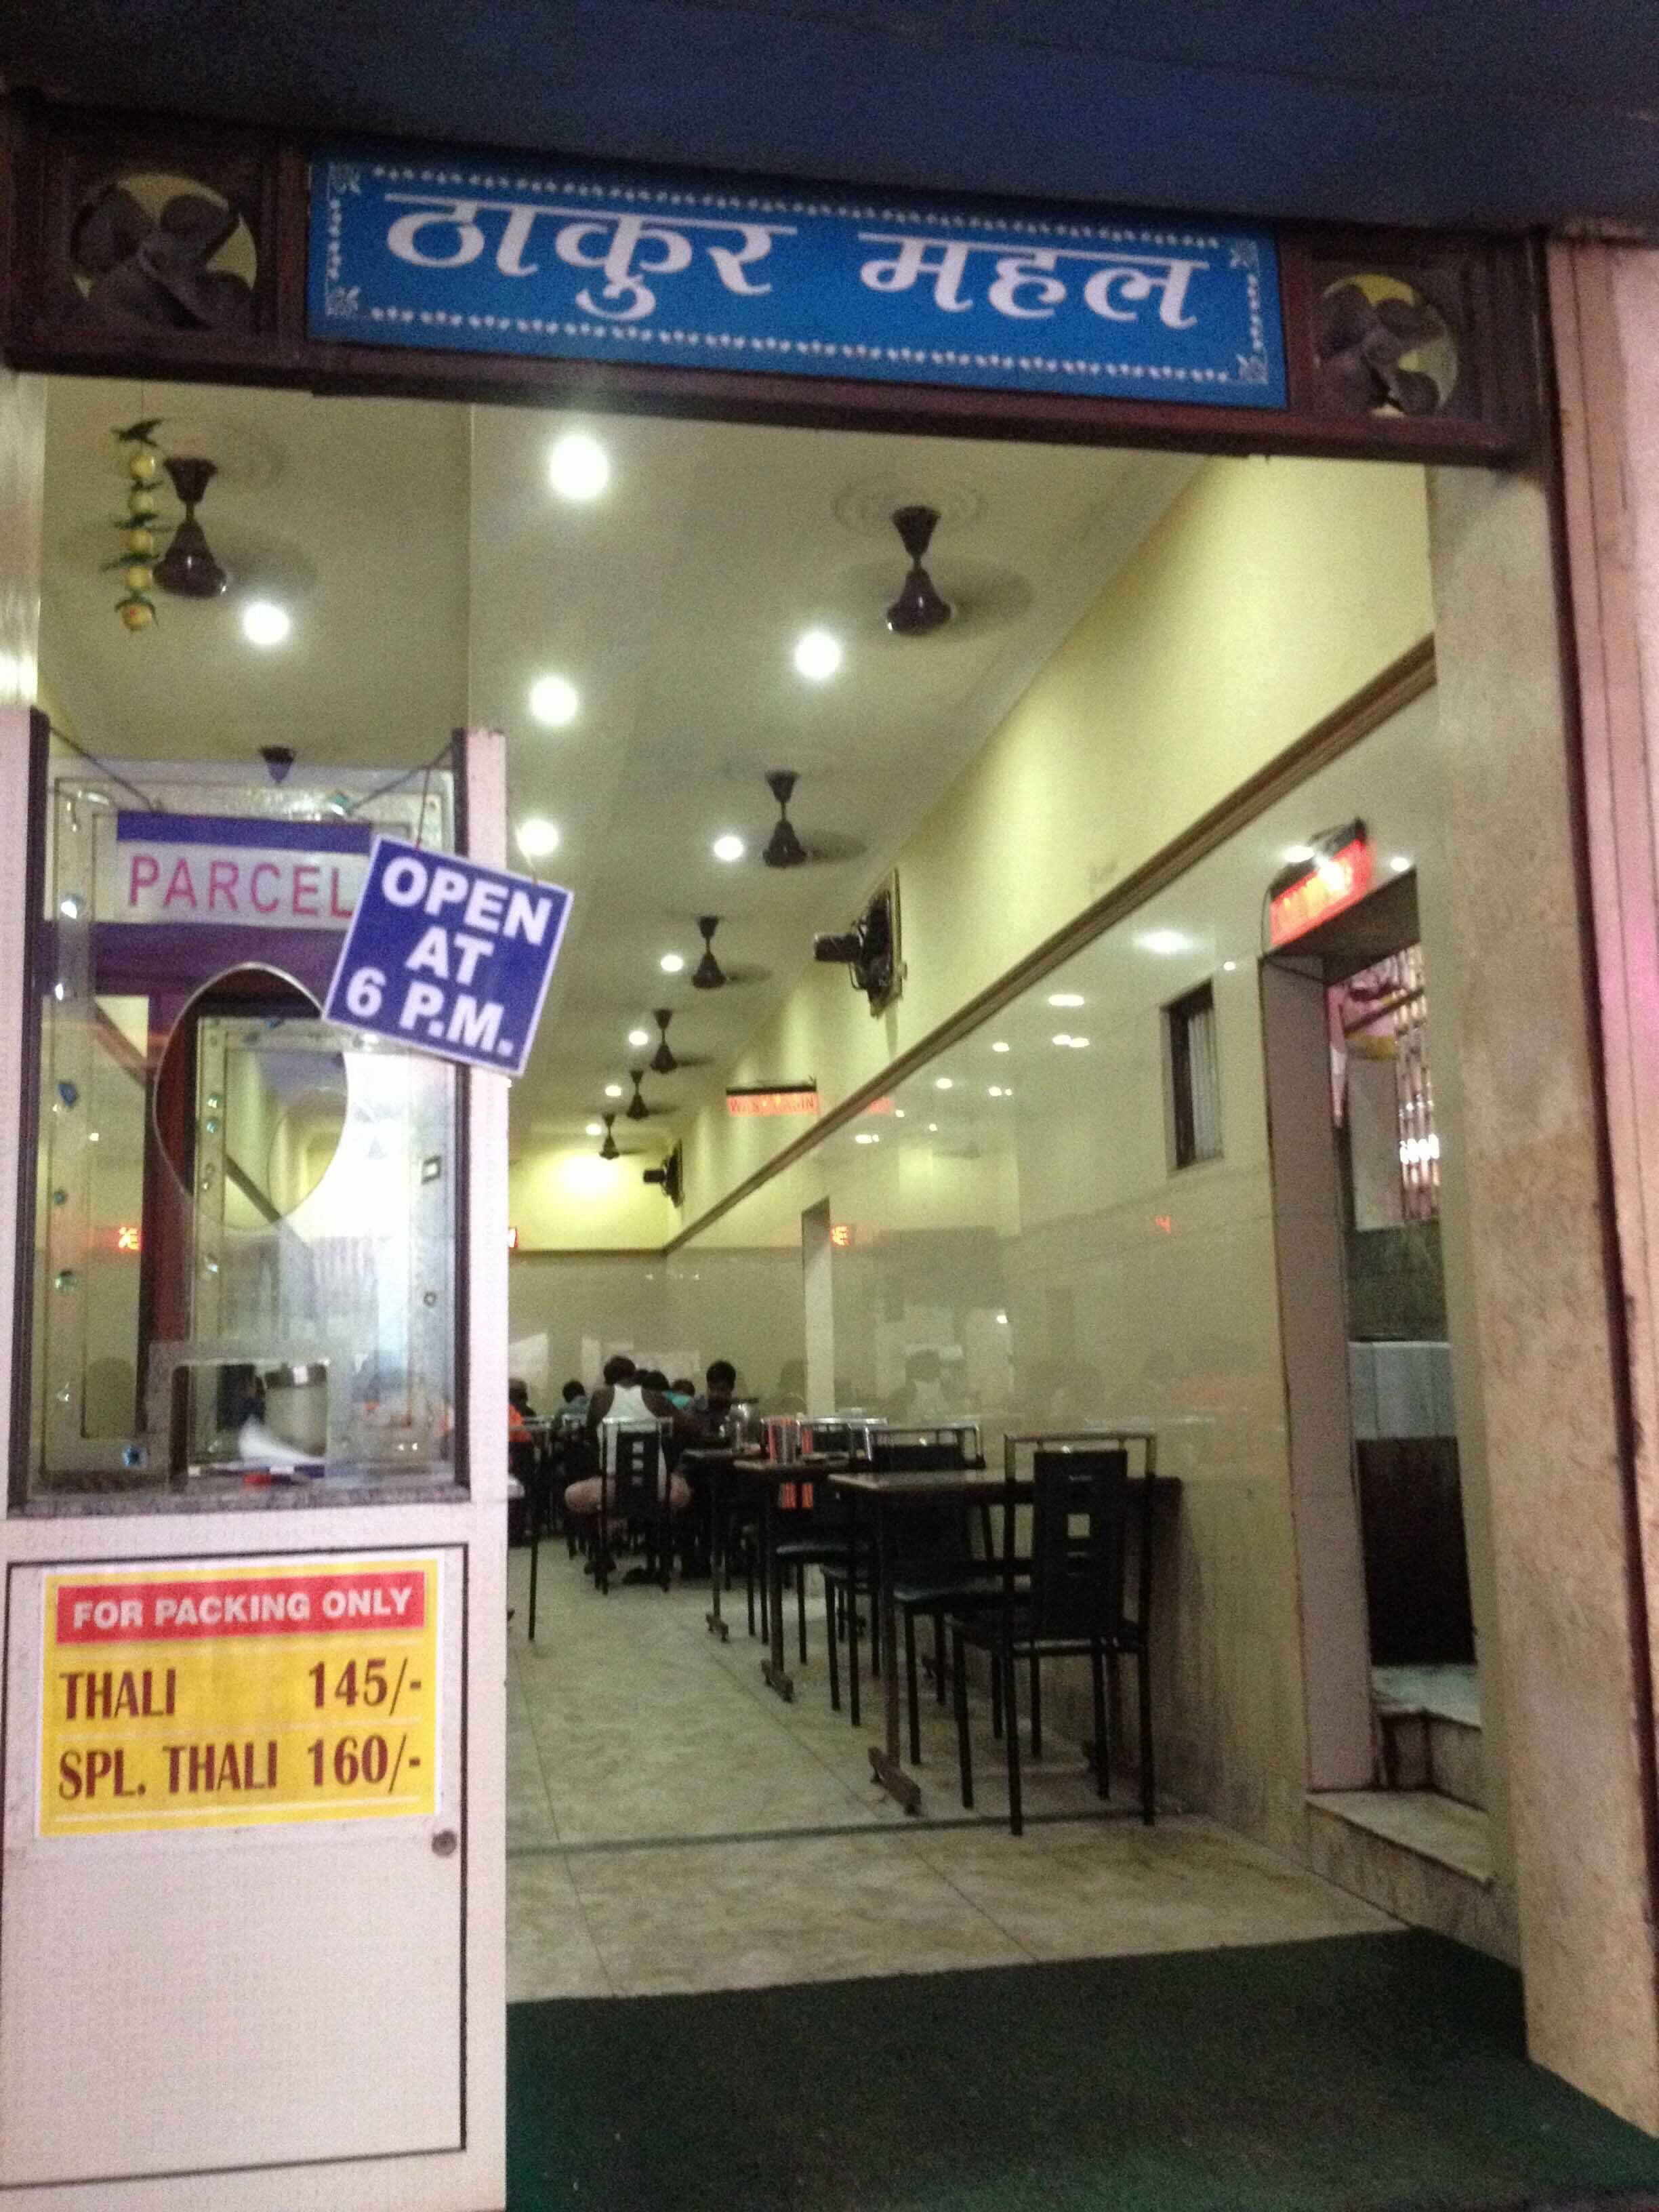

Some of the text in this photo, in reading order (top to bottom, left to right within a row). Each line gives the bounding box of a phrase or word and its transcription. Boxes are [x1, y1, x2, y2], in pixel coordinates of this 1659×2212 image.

[384, 193, 1210, 329] ठाकुर महल
[129, 855, 354, 918] PARCEL
[382, 858, 552, 944] OPEN
[408, 927, 493, 985] AT
[346, 966, 513, 1057] 6 P.M.
[73, 1588, 413, 1630] FOR PACKING ONLY
[60, 1657, 422, 1720] THALI 145/-
[58, 1734, 422, 1801] SPL. THALI 160/-
